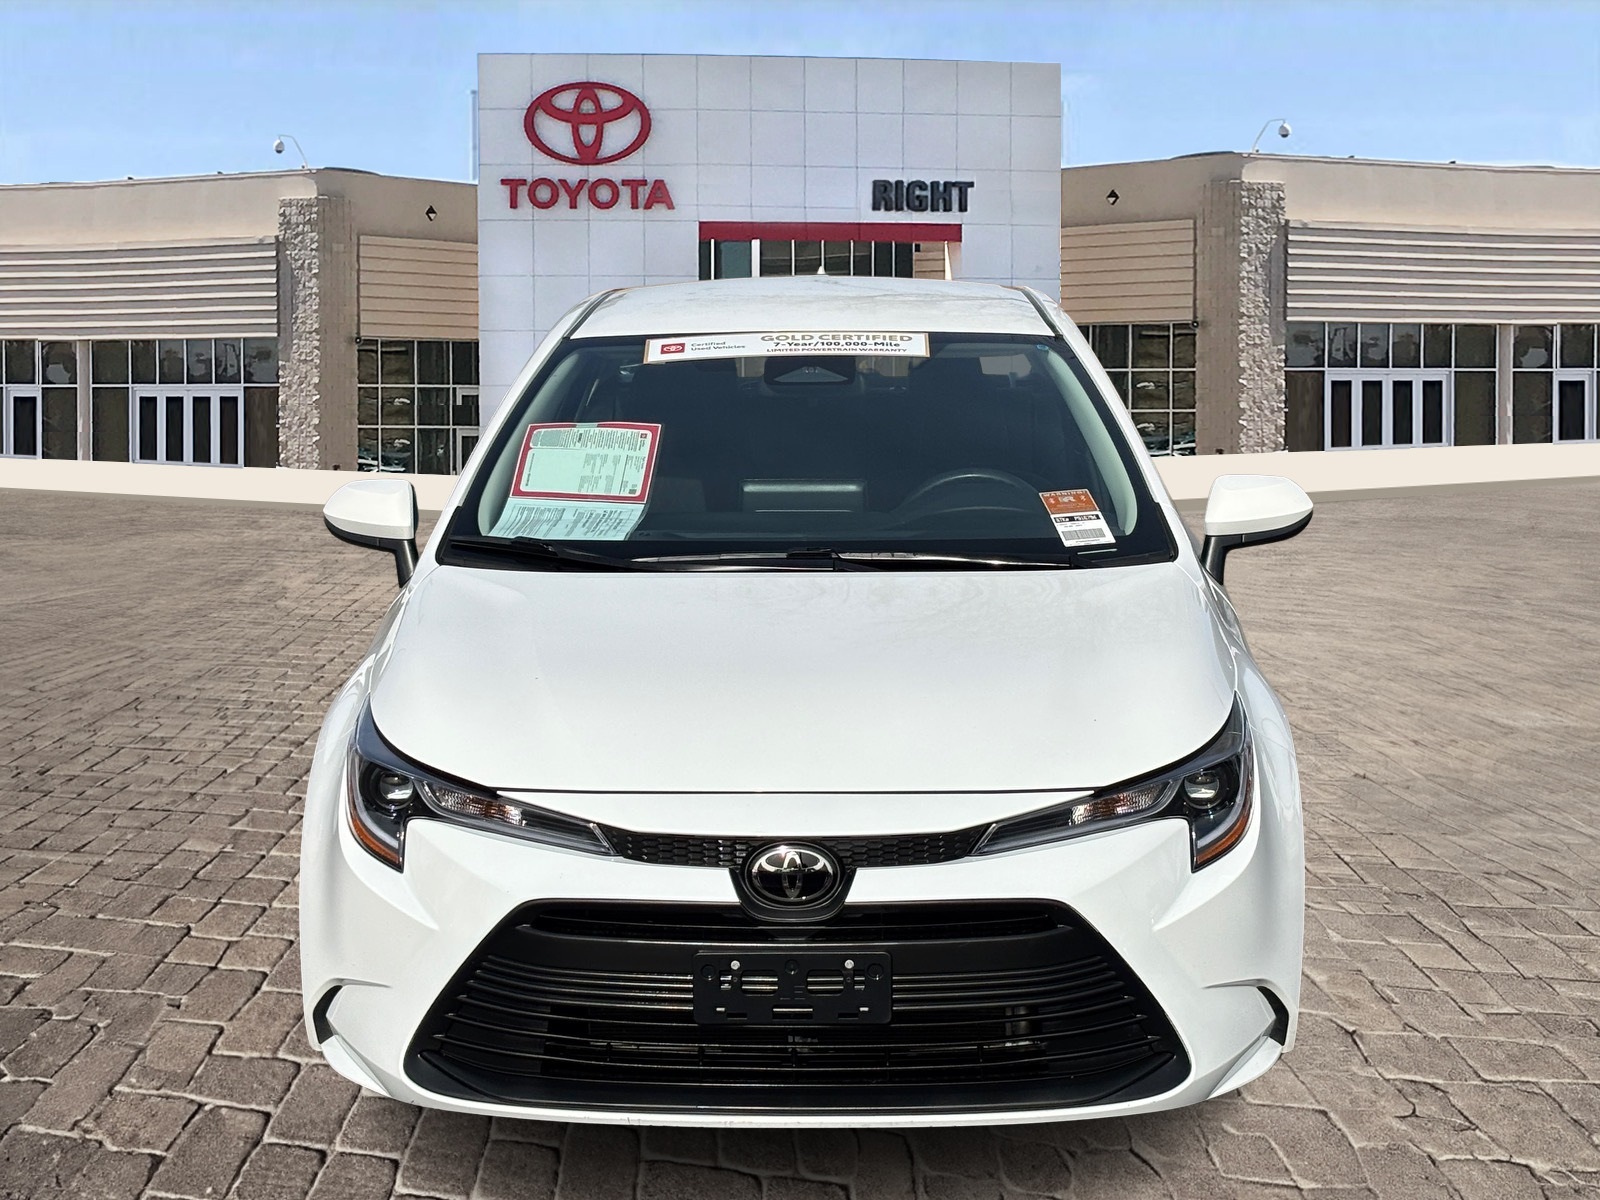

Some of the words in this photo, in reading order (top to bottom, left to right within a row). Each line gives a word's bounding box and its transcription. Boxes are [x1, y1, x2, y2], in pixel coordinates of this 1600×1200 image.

[500, 177, 675, 210] TOYOTA
[872, 179, 975, 212] RIGHT
[760, 334, 814, 342] GOLD
[818, 334, 913, 342] CERTIFIED
